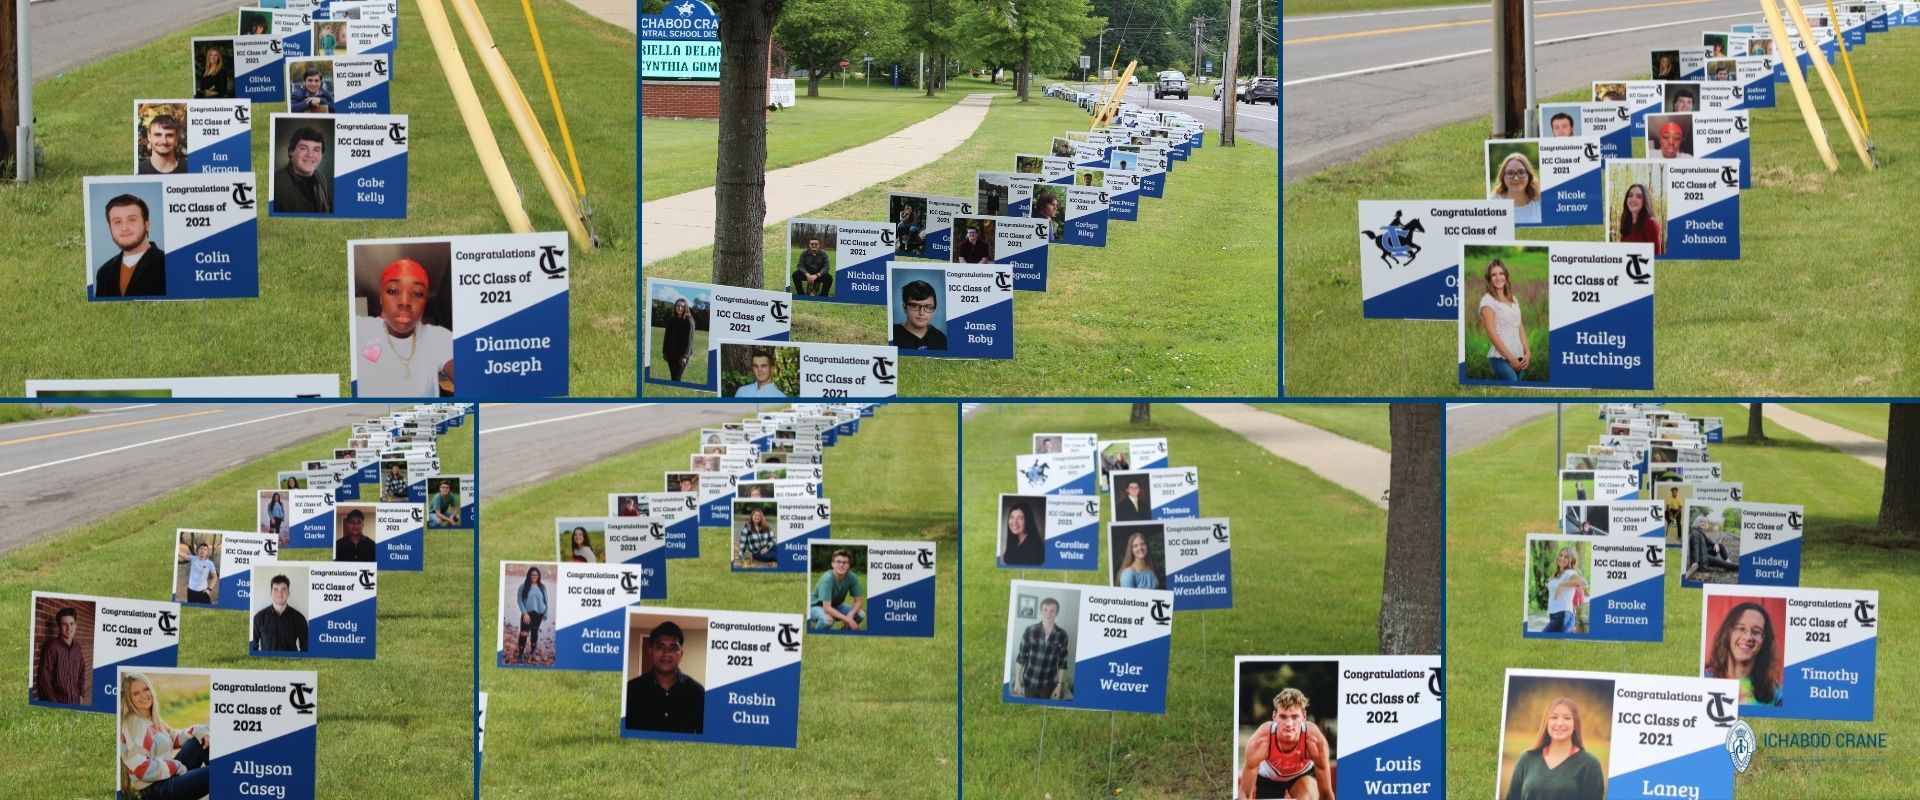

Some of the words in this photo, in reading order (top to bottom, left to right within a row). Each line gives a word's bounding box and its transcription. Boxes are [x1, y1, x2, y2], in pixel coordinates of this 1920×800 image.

[245, 85, 276, 93] Lambert
[348, 101, 377, 109] Joshua
[213, 153, 228, 161] Ian
[351, 149, 371, 157] 2021
[357, 177, 385, 188] Gabe
[166, 185, 230, 195] Congratulations
[1557, 190, 1586, 200] Nicole
[357, 192, 384, 204] Kelly
[1684, 192, 1704, 200] 2021
[169, 204, 186, 213] ICC
[188, 203, 214, 212] Class
[216, 202, 227, 212] of
[1430, 207, 1507, 219] Congratulations
[1556, 203, 1588, 212] Jornov
[186, 217, 211, 227] 2021
[1685, 220, 1724, 229] Phoebe
[1078, 230, 1094, 238] Riley
[1444, 226, 1460, 235] ICC
[1461, 226, 1486, 235] Class
[1487, 226, 1497, 235] of
[1682, 234, 1727, 244] Johnson
[195, 251, 230, 264] Colin
[456, 249, 536, 262] Congratulations
[850, 248, 866, 256] 2021
[1551, 254, 1623, 265] Congratulations
[195, 269, 231, 281] Karic
[459, 274, 480, 285] ICC
[483, 272, 516, 284] Class
[519, 271, 532, 283] of
[847, 271, 884, 281] Nicholas
[1553, 275, 1572, 285] ICC
[1575, 275, 1605, 286] Class
[1607, 275, 1619, 286] of
[851, 282, 880, 292] Robles
[480, 290, 512, 304] 2021
[715, 294, 769, 306] Congratulations
[961, 295, 979, 303] 2021
[1572, 291, 1600, 302] 2021
[730, 323, 751, 333] 2021
[964, 321, 996, 331] James
[476, 336, 550, 352] Diamone
[968, 334, 993, 346] Roby
[1576, 331, 1626, 349] Hailey
[803, 355, 870, 365] Congratulations
[1562, 352, 1641, 369] Hutchings
[484, 357, 542, 376] Joseph
[806, 373, 823, 383] ICC
[825, 374, 853, 384] Class
[855, 376, 866, 385] of
[1754, 532, 1771, 540] 2021
[1055, 540, 1089, 549] Caroline
[869, 548, 916, 556] Congratulations
[1060, 551, 1084, 559] White
[1180, 548, 1198, 556] 2021
[1752, 556, 1789, 569] Lindsey
[566, 571, 619, 580] Congratulations
[882, 572, 901, 580] 2021
[1174, 572, 1225, 583] Mackenzie
[1607, 571, 1627, 579] 2021
[1755, 569, 1784, 578] Bartle
[325, 583, 345, 591] Class
[346, 583, 355, 591] of
[1174, 585, 1227, 596] Wendelken
[324, 594, 342, 602] 2021
[581, 598, 601, 607] 2021
[1088, 596, 1149, 607] Congratulations
[886, 599, 916, 610] Dylan
[1608, 599, 1646, 610] Brooke
[1788, 599, 1852, 609] Congratulations
[101, 607, 156, 618] Congratulations
[884, 611, 917, 622] Clarke
[1089, 613, 1106, 623] ICC
[1107, 614, 1132, 625] Class
[1134, 616, 1144, 625] of
[1605, 614, 1648, 625] Barmen
[1790, 617, 1807, 627] ICC
[1809, 617, 1835, 628] Class
[1837, 618, 1848, 628] of
[327, 620, 357, 632] Brody
[710, 621, 775, 632] Congratulations
[319, 633, 366, 643] Chandler
[581, 628, 621, 639] Ariana
[1104, 627, 1127, 638] 2021
[1806, 631, 1831, 642] 2021
[116, 637, 138, 648] 2021
[582, 642, 619, 654] Clarke
[711, 640, 728, 650] ICC
[731, 641, 758, 651] Class
[760, 642, 771, 652] of
[727, 655, 753, 666] 2021
[1108, 662, 1143, 677] Tyler
[1343, 669, 1425, 681] Congratulations
[1801, 667, 1858, 684] Timothy
[212, 682, 286, 693] Congratulations
[1100, 678, 1149, 693] Weaver
[1346, 693, 1367, 704] ICC
[1370, 692, 1404, 704] Class
[1406, 692, 1420, 704] of
[1617, 688, 1703, 702] Congratulations
[1810, 686, 1849, 699] Balon
[728, 692, 776, 706] Rosbin
[214, 703, 234, 714] ICC
[236, 704, 267, 715] Class
[269, 704, 282, 715] of
[733, 711, 769, 725] Chun
[1366, 711, 1398, 723] 2021
[1618, 712, 1641, 724] ICC
[1643, 714, 1679, 727] Class
[1685, 715, 1698, 728] of
[233, 720, 262, 732] 2021
[1639, 732, 1673, 746] 2021
[232, 761, 292, 778] Allyson
[1376, 756, 1421, 772] Louis
[239, 782, 285, 799] Casey
[1364, 780, 1431, 795] Warner
[1642, 780, 1699, 800] Laney
